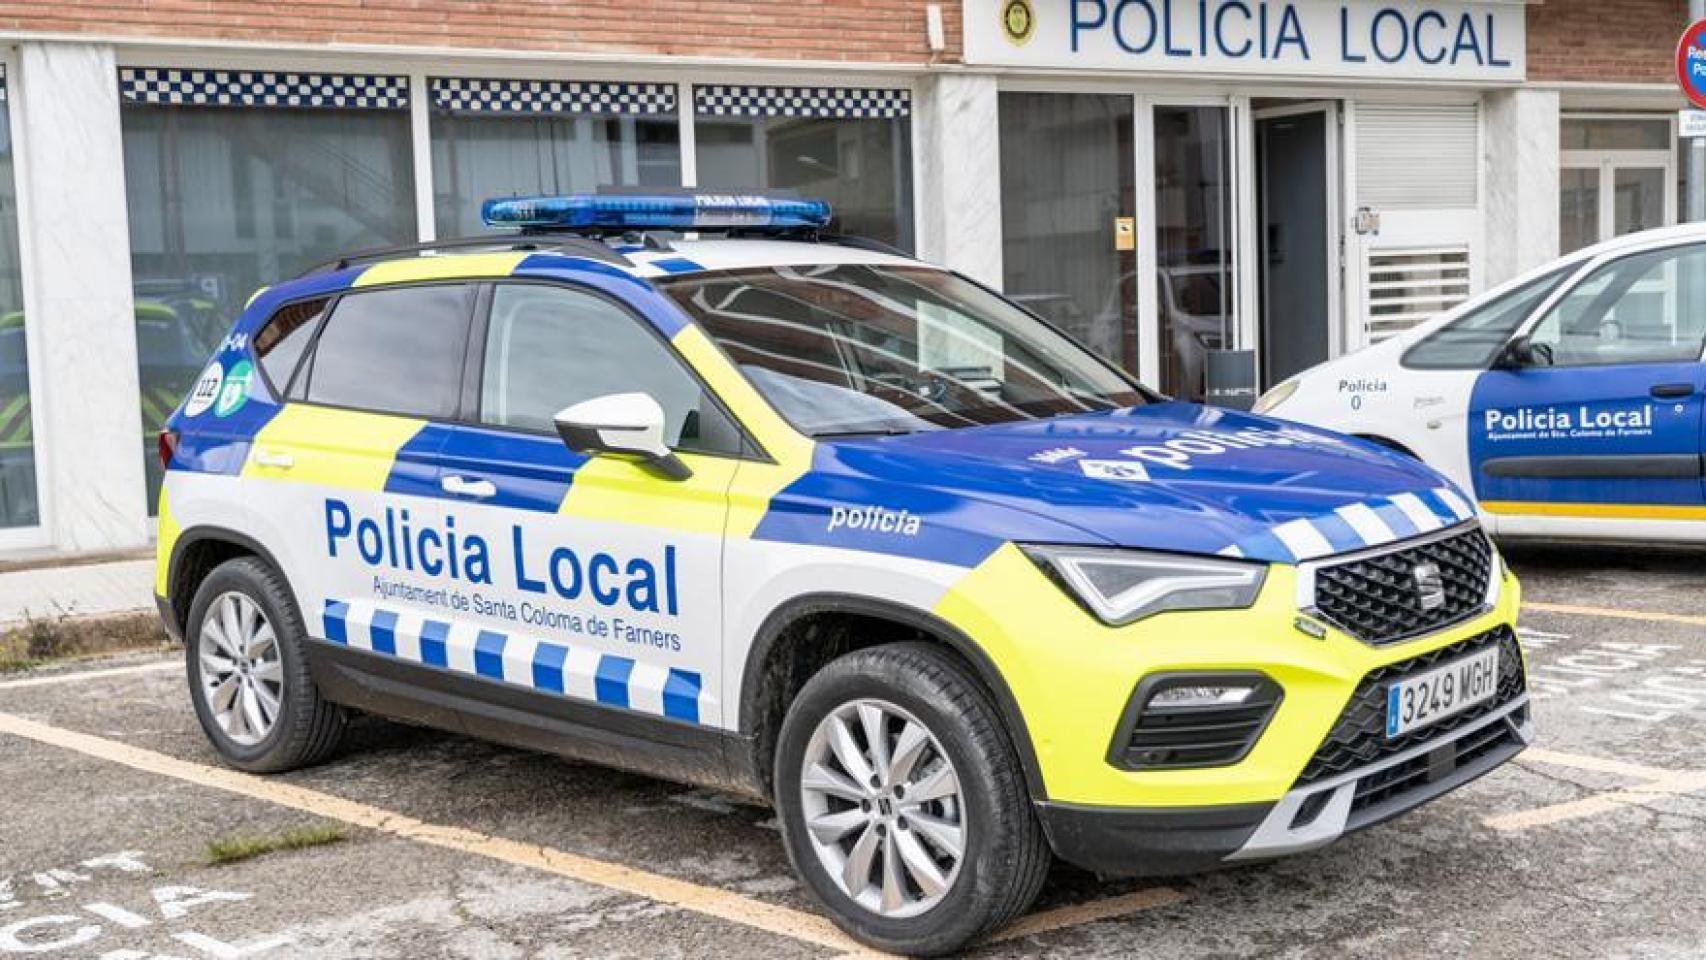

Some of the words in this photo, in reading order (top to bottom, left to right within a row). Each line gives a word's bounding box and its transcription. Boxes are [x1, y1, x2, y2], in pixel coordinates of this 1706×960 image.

[1069, 0, 1310, 60] POLICIA
[1341, 7, 1512, 67] LOCAL
[1338, 379, 1387, 392] Policia
[1485, 407, 1571, 430] Policia
[1580, 405, 1652, 428] Local
[325, 498, 492, 585] Policia
[512, 524, 678, 616] Local
[373, 575, 448, 607] Ajuntament
[451, 588, 470, 611] de
[473, 592, 516, 620] Santa
[520, 602, 582, 633] Coloma
[587, 614, 608, 637] de
[613, 618, 681, 651] Farners
[1402, 674, 1455, 725] 3249
[1459, 655, 1494, 701] MGH
